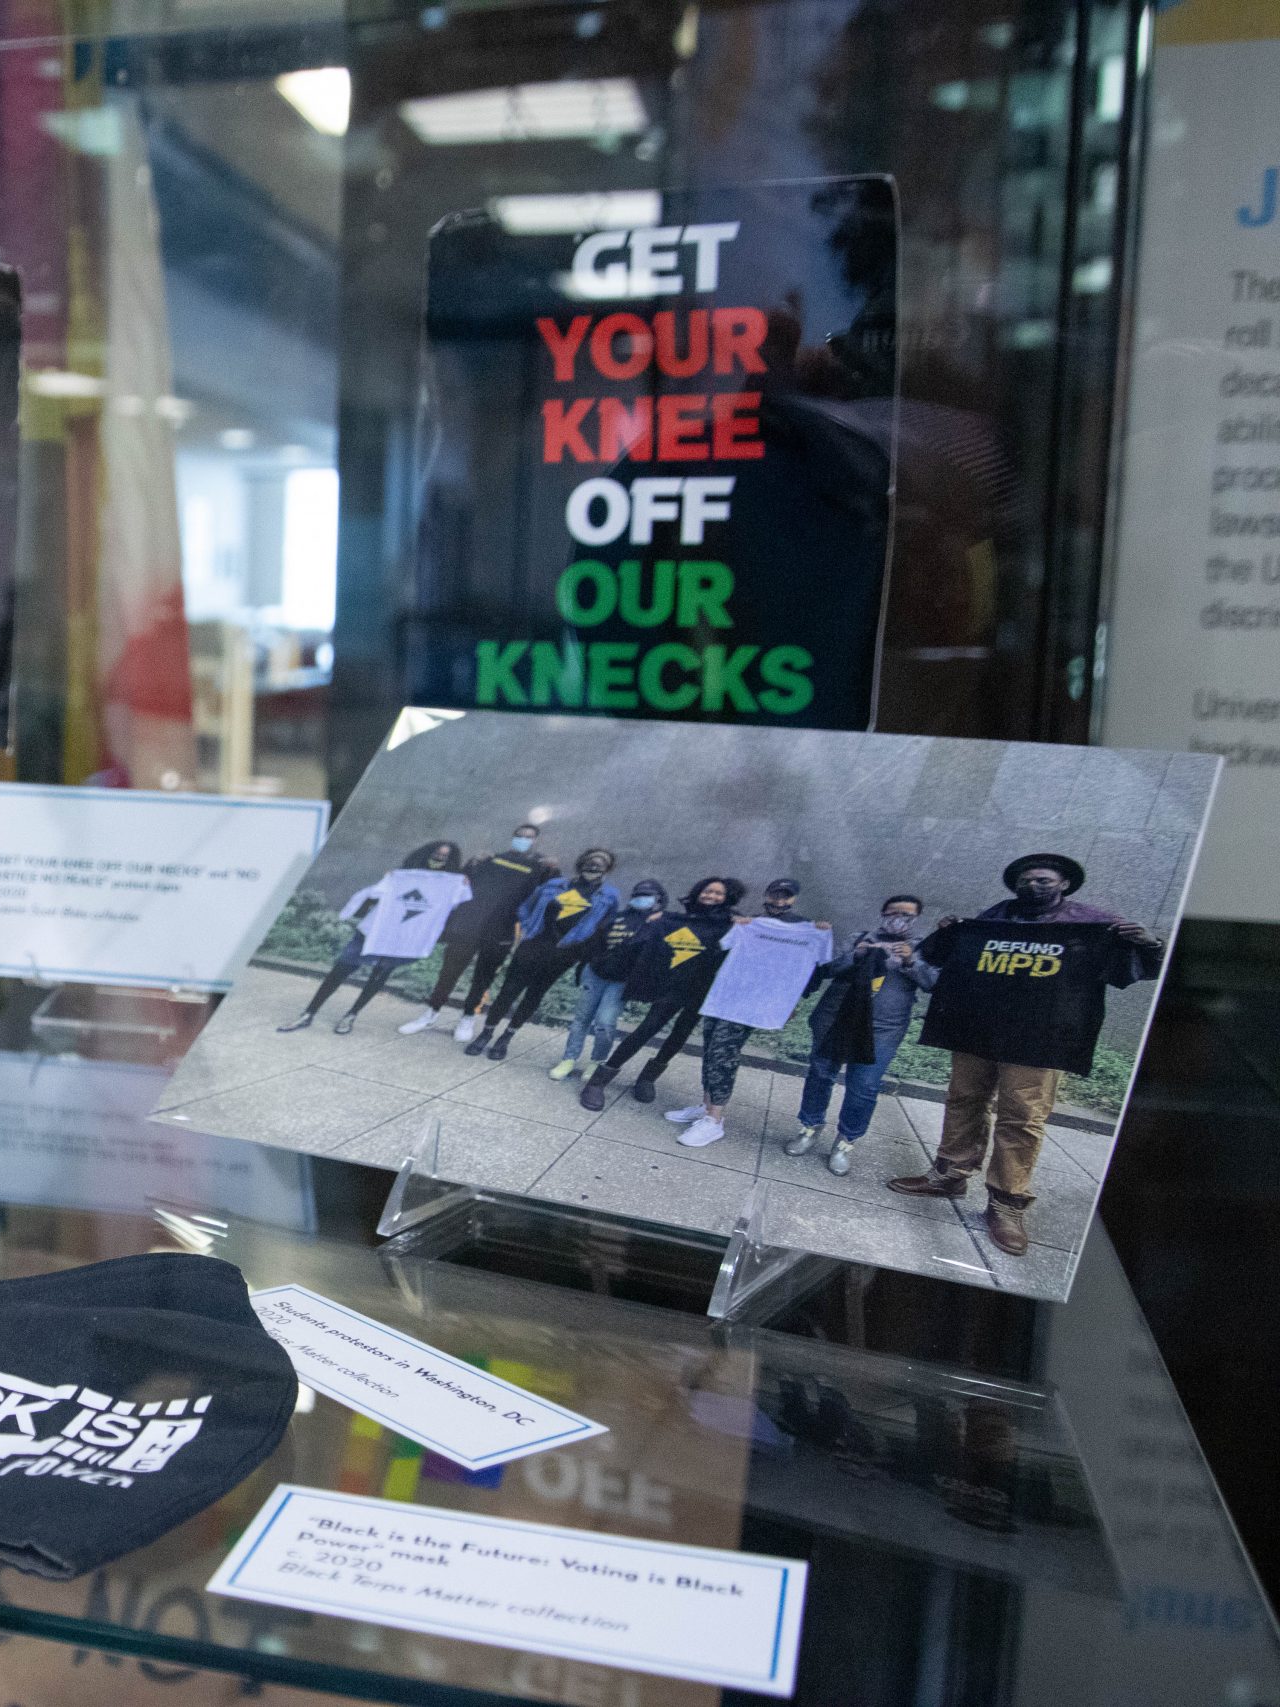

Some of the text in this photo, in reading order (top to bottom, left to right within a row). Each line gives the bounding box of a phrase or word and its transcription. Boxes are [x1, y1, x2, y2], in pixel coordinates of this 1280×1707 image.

[572, 223, 740, 300] GET
[536, 307, 769, 382] YOUR
[541, 393, 765, 463] KNEE
[566, 477, 735, 545] OFF
[556, 560, 734, 629] OUR
[475, 641, 814, 714] KNECKS
[976, 951, 1062, 977] MPD
[983, 939, 1065, 956] DEFUND
[272, 1300, 537, 1428] Students protestors in Washington, DC
[292, 1343, 339, 1370] Matter
[335, 1364, 401, 1400] collection
[59, 1407, 142, 1448] IS
[131, 1423, 187, 1472] THE
[314, 1551, 384, 1573] 2020
[387, 1530, 406, 1543] is
[413, 1535, 452, 1550] the
[460, 1542, 549, 1567] Future:
[559, 1557, 639, 1583] Voting
[648, 1572, 666, 1586] is
[675, 1575, 745, 1598] Black
[389, 1549, 451, 1568] mask
[277, 1561, 632, 1632] Black Terps Matter collection
